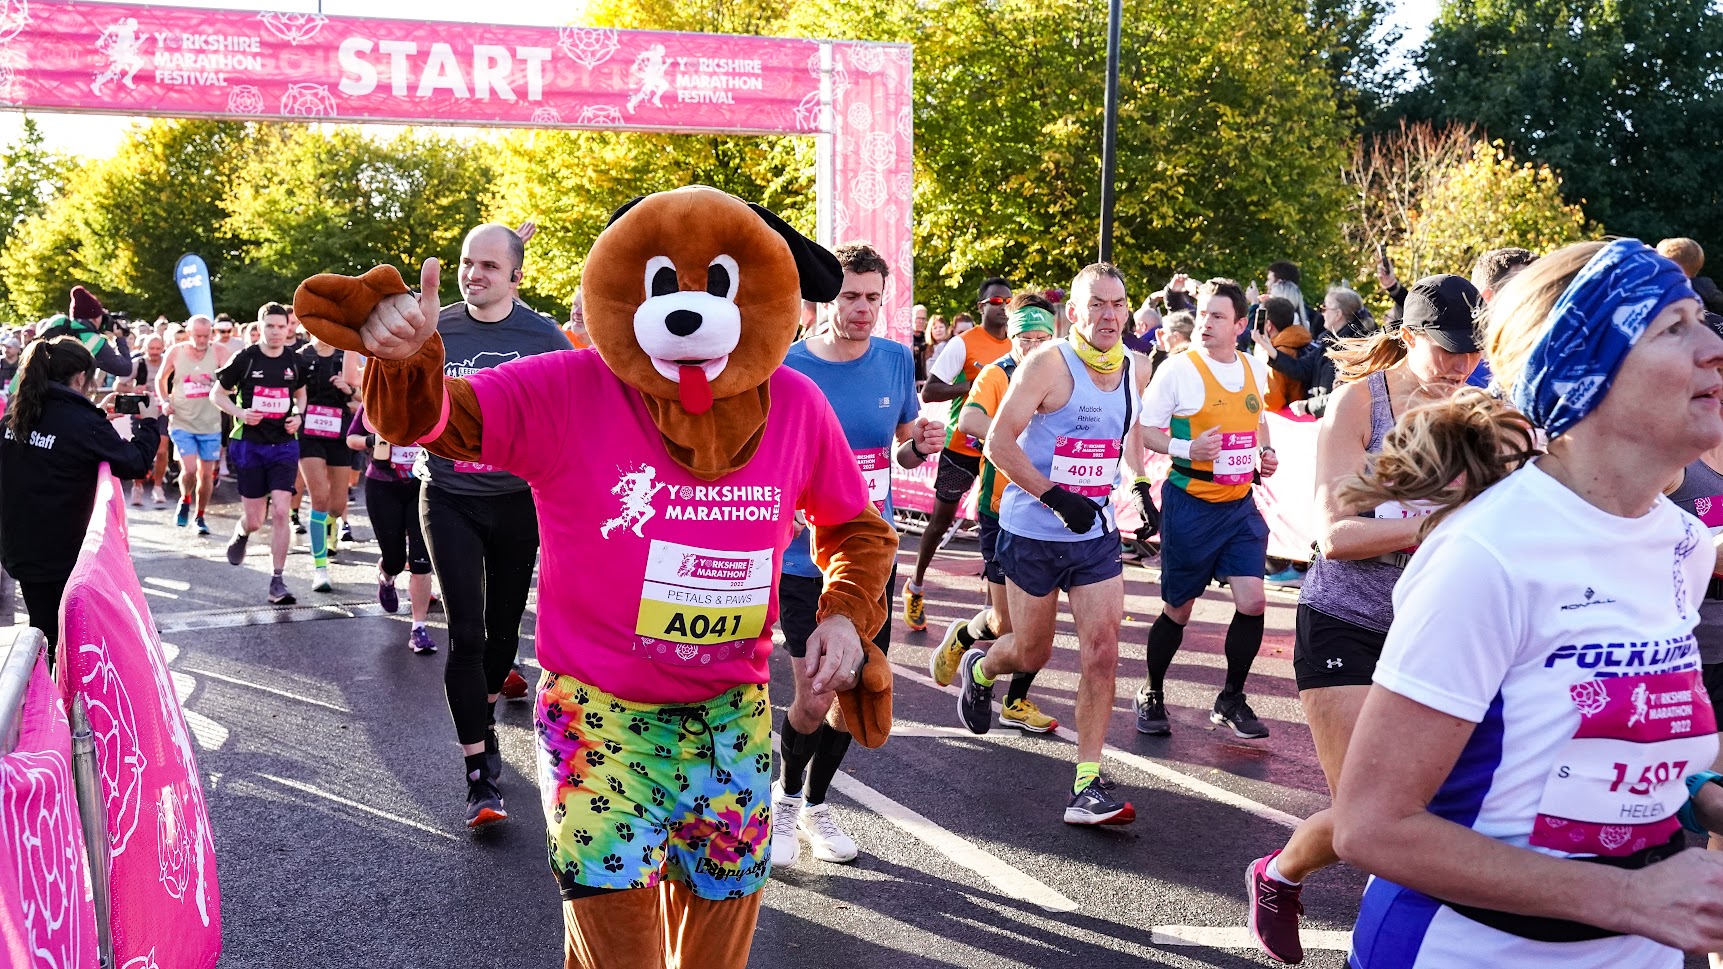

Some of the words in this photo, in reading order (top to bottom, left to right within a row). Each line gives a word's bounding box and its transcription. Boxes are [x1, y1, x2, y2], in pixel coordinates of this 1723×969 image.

[154, 52, 262, 71] MARATHON
[337, 37, 553, 101] START
[155, 69, 228, 86] FESTIVAL
[676, 73, 762, 90] MARATHON
[677, 89, 736, 104] FESTIVAL
[1077, 415, 1101, 423] Athletic
[29, 430, 56, 450] Staff
[1228, 455, 1252, 466] 3805
[1068, 465, 1104, 477] 4018
[666, 484, 772, 501] YORKSHIRE
[772, 486, 782, 521] RELAY
[665, 505, 772, 521] MARATHON
[696, 568, 747, 578] MARATHON
[667, 590, 713, 605] PETALS
[715, 595, 722, 604] &
[725, 594, 753, 605] PAWS
[663, 612, 742, 639] A041
[1648, 705, 1693, 720] MARATHON
[1670, 719, 1692, 734] 2022
[1557, 765, 1571, 779] S
[1609, 760, 1689, 796] 1597
